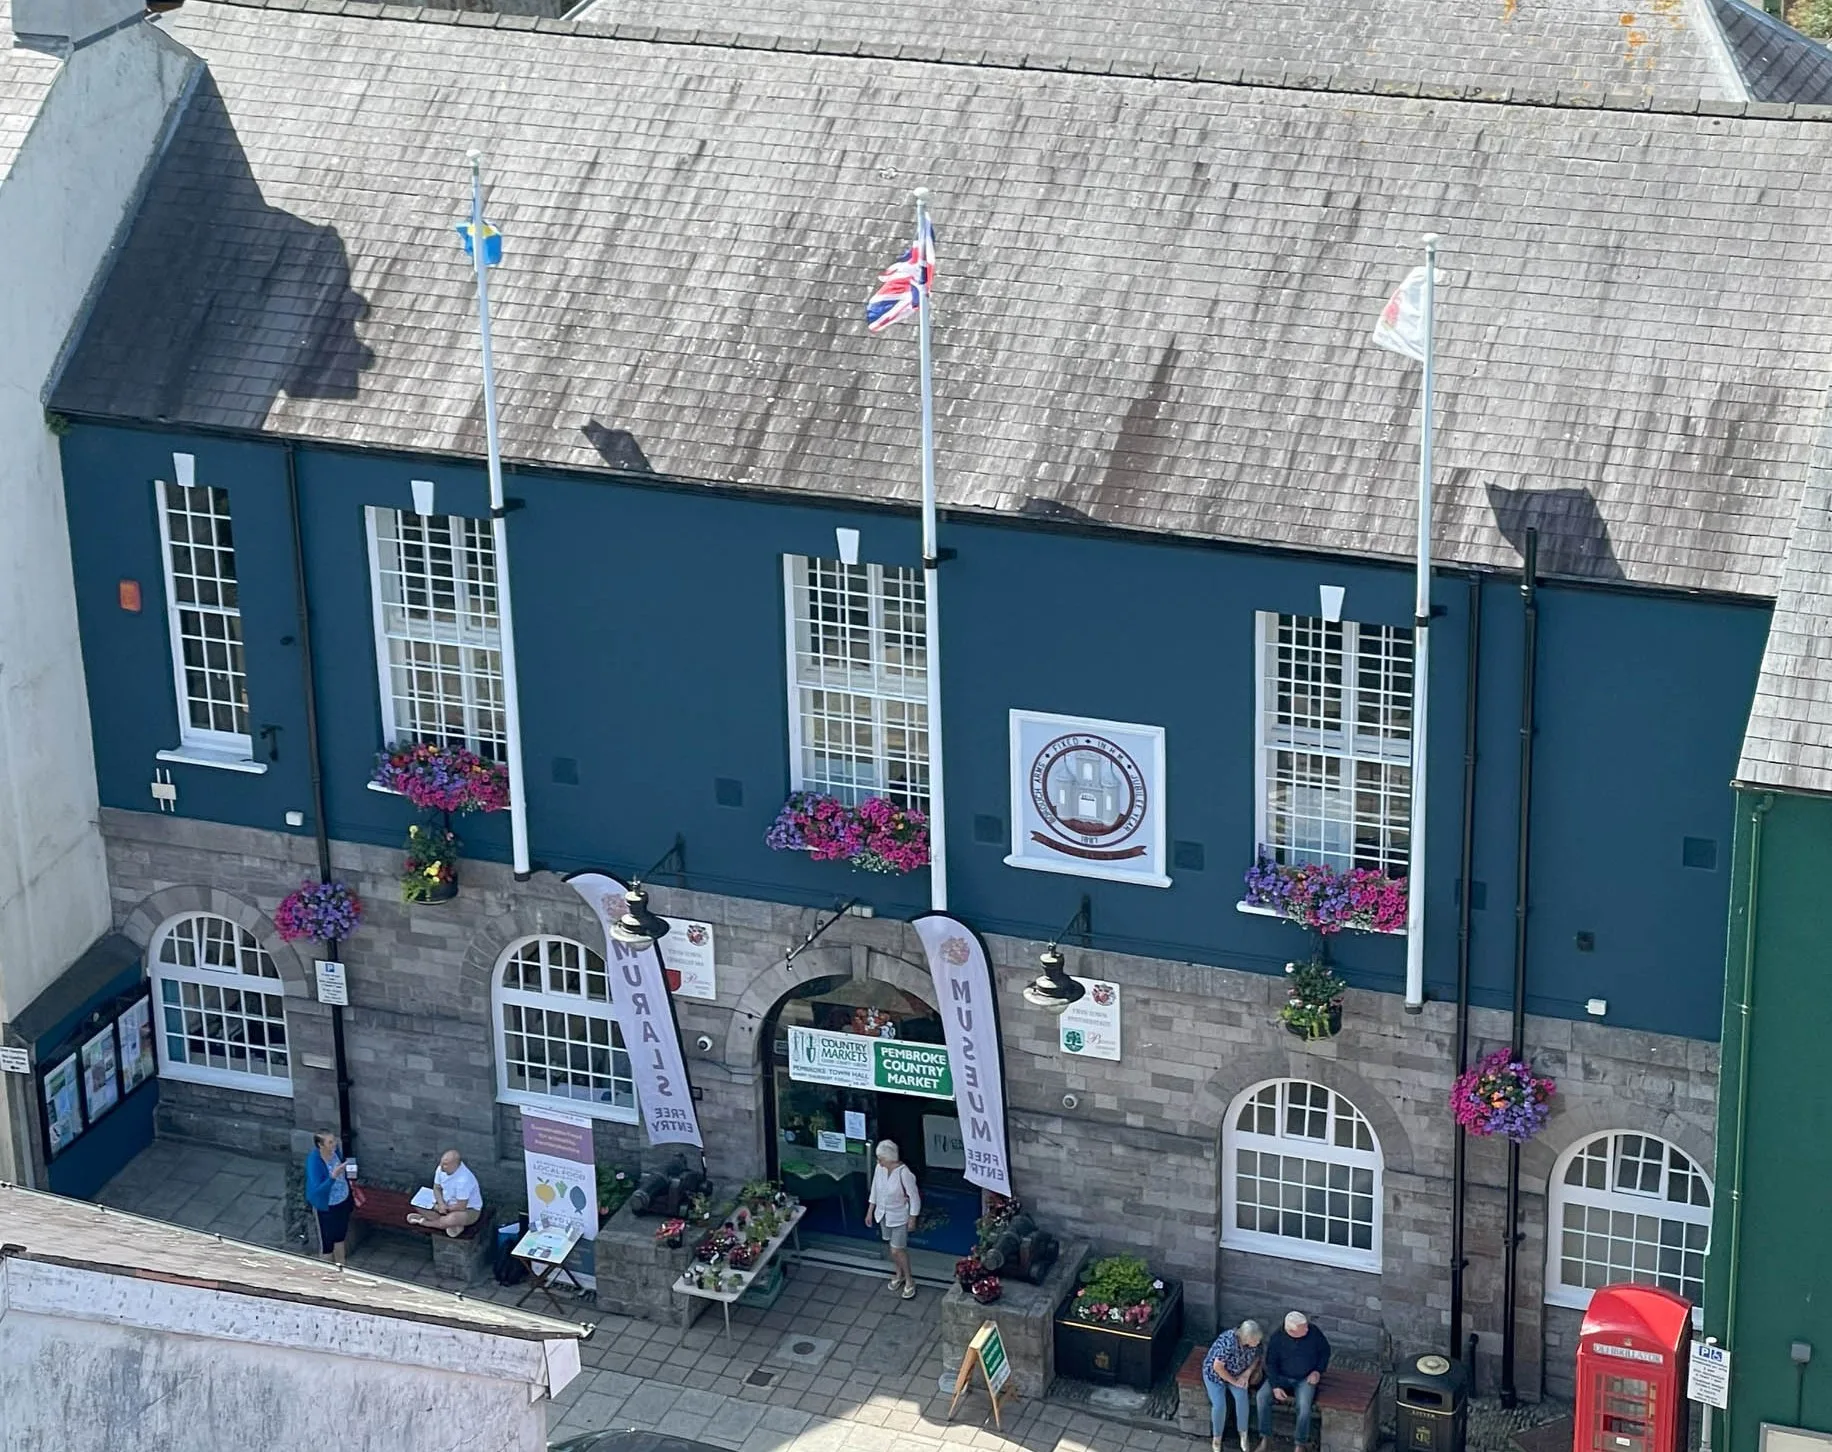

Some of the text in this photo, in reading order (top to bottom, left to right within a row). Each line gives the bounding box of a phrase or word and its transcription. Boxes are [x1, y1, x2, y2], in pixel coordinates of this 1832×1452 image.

[1052, 738, 1079, 752] FIXED
[1033, 762, 1046, 784] ARMS
[1131, 774, 1144, 809] JUBILEE
[1123, 813, 1140, 832] YEAR
[821, 1038, 867, 1052] COUNTRY
[821, 1048, 868, 1062] MARKETS
[880, 1047, 947, 1065] PEMBROKE
[852, 1071, 870, 1079] HALL
[883, 1059, 945, 1077] COUNTRY
[887, 1073, 940, 1089] MARKET
